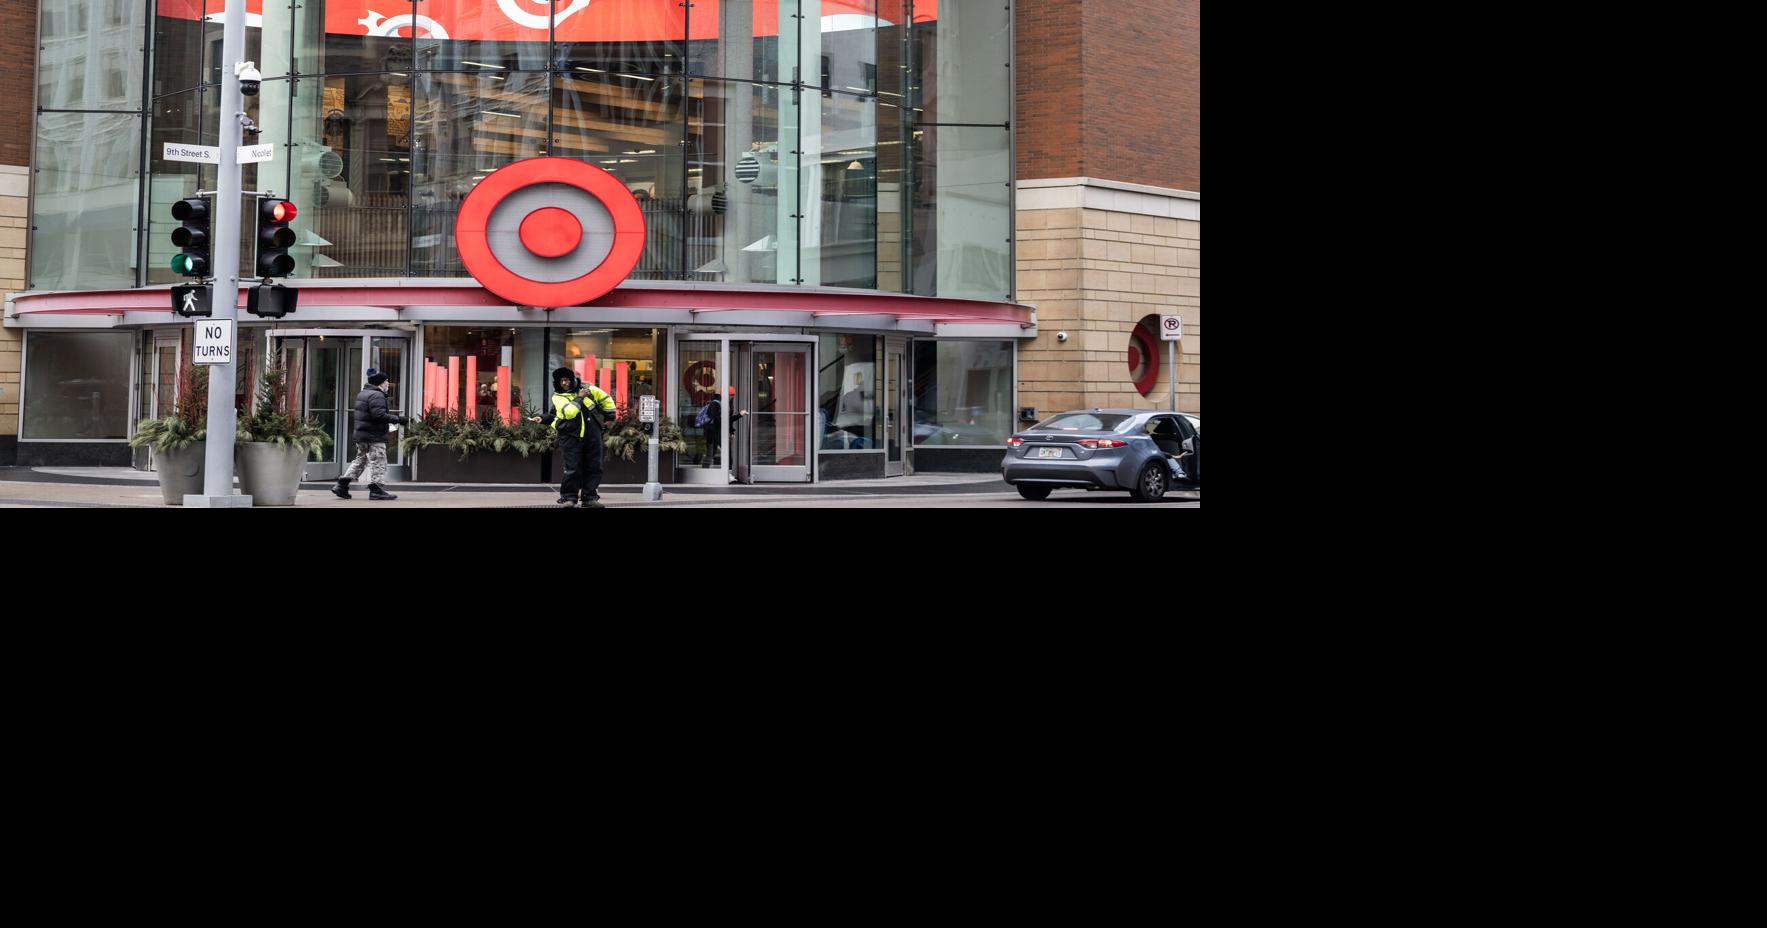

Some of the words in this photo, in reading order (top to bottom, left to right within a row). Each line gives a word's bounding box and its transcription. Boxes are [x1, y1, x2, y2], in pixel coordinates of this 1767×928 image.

[166, 147, 180, 156] 9th
[181, 149, 202, 158] Street
[205, 326, 222, 339] NO
[196, 345, 230, 357] TURNS
